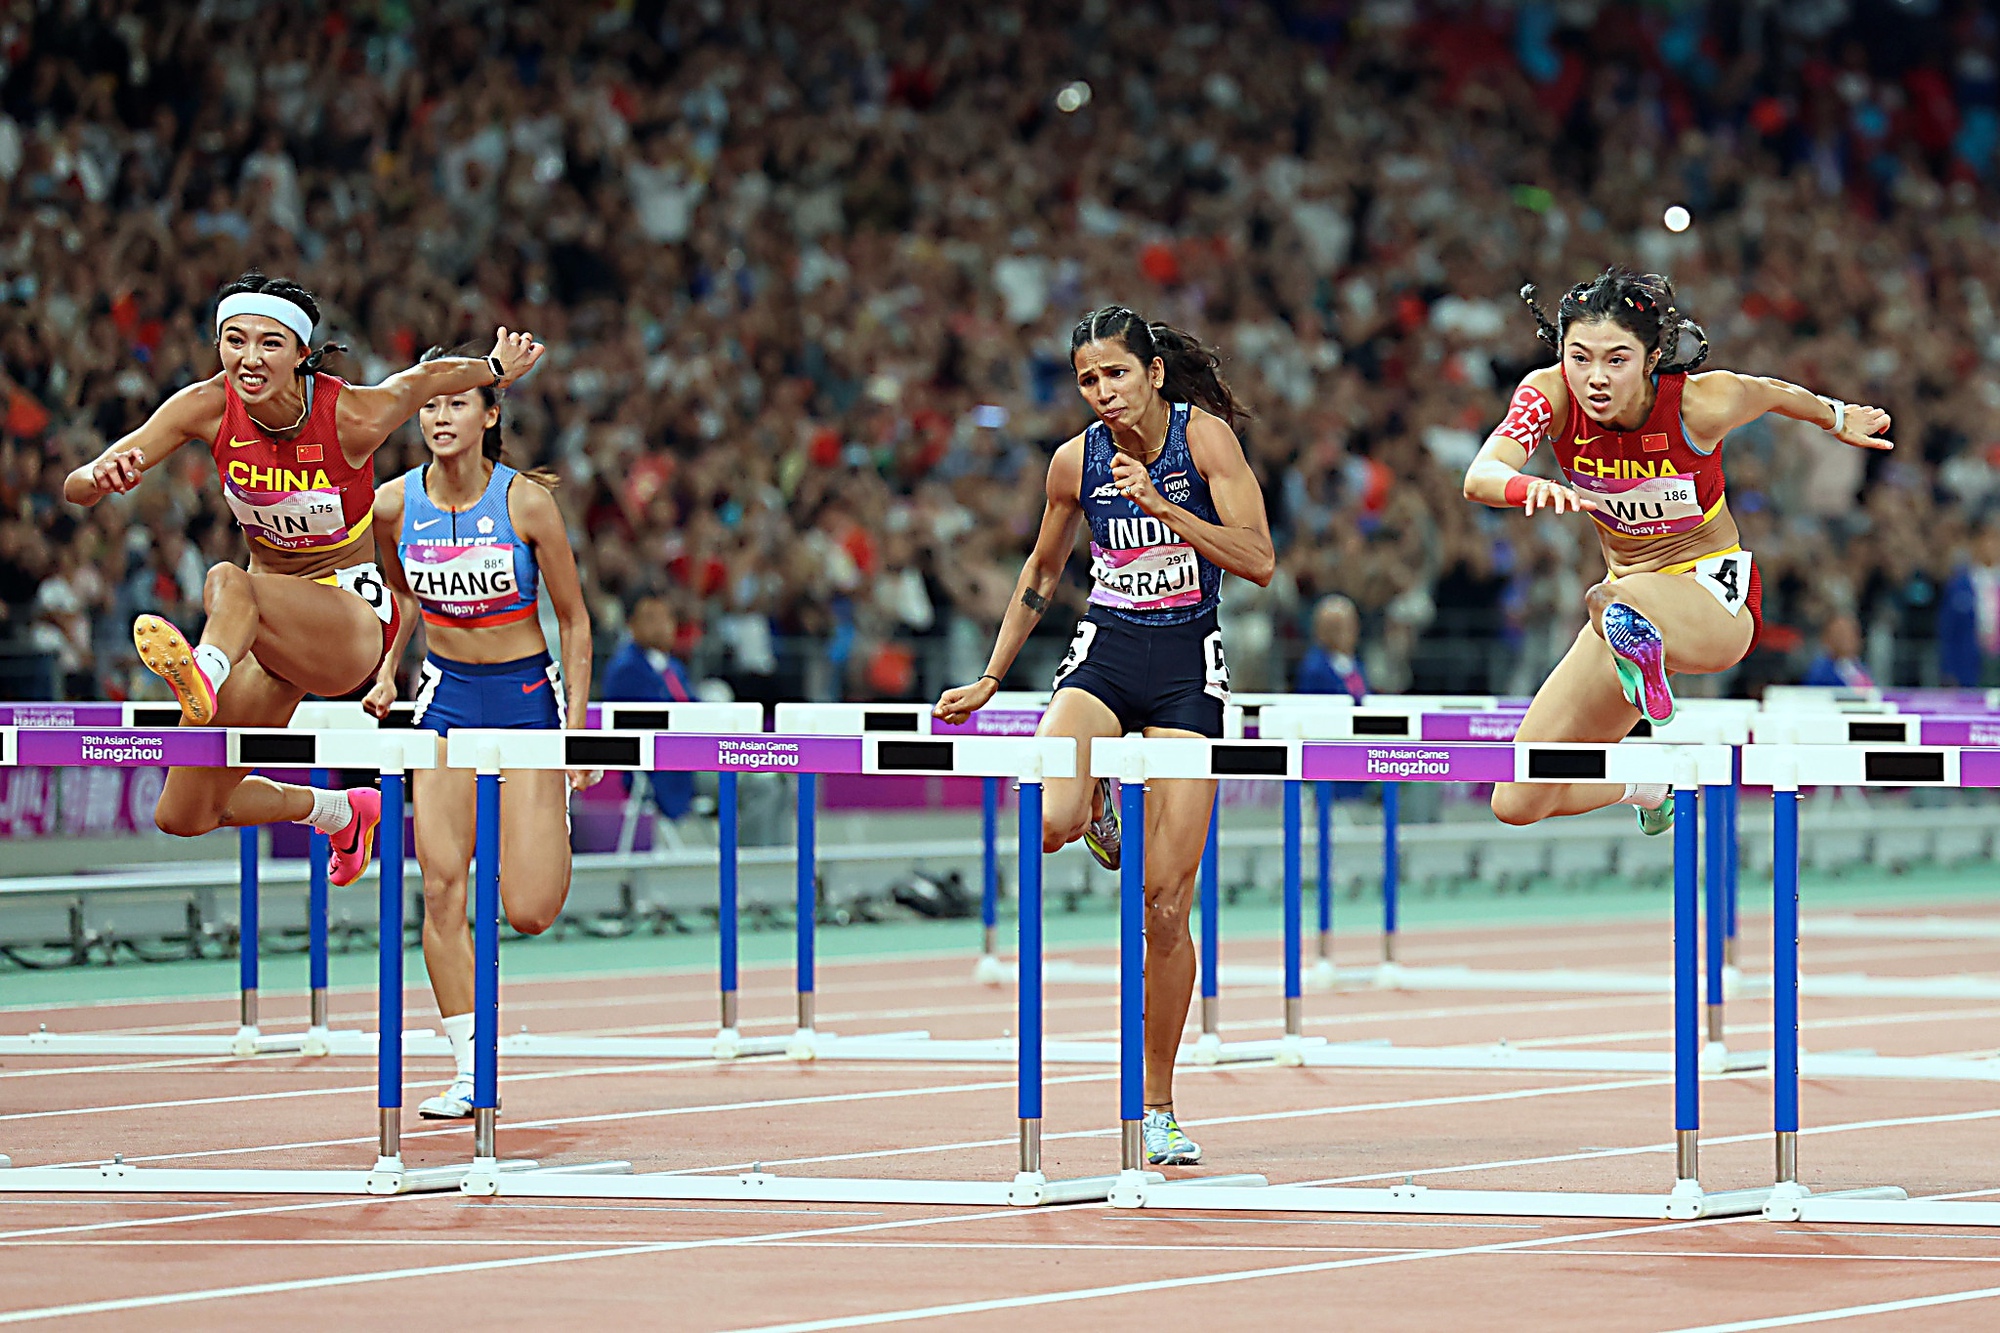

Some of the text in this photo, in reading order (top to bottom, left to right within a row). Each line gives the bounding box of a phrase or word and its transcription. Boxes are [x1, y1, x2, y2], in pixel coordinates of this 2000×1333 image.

[228, 460, 333, 492] CHINA
[1573, 455, 1679, 479] CHINA
[1164, 478, 1190, 492] INDIA
[1664, 490, 1688, 501] 186
[309, 503, 333, 514] 175
[1605, 500, 1664, 521] WU
[253, 510, 310, 534] LIN
[1108, 517, 1181, 549] INDI
[484, 559, 504, 569] 885
[1166, 554, 1188, 566] 297
[410, 571, 511, 596] ZHANG
[1708, 558, 1738, 603] 4
[82, 736, 163, 746] 19th Asian Games
[718, 741, 799, 751] 19th Asian Games
[82, 745, 163, 763] Hangzhou
[718, 750, 799, 768] Hangzhou
[1367, 749, 1450, 760] 19th Asian Games
[1367, 759, 1450, 777] Hangzhou
